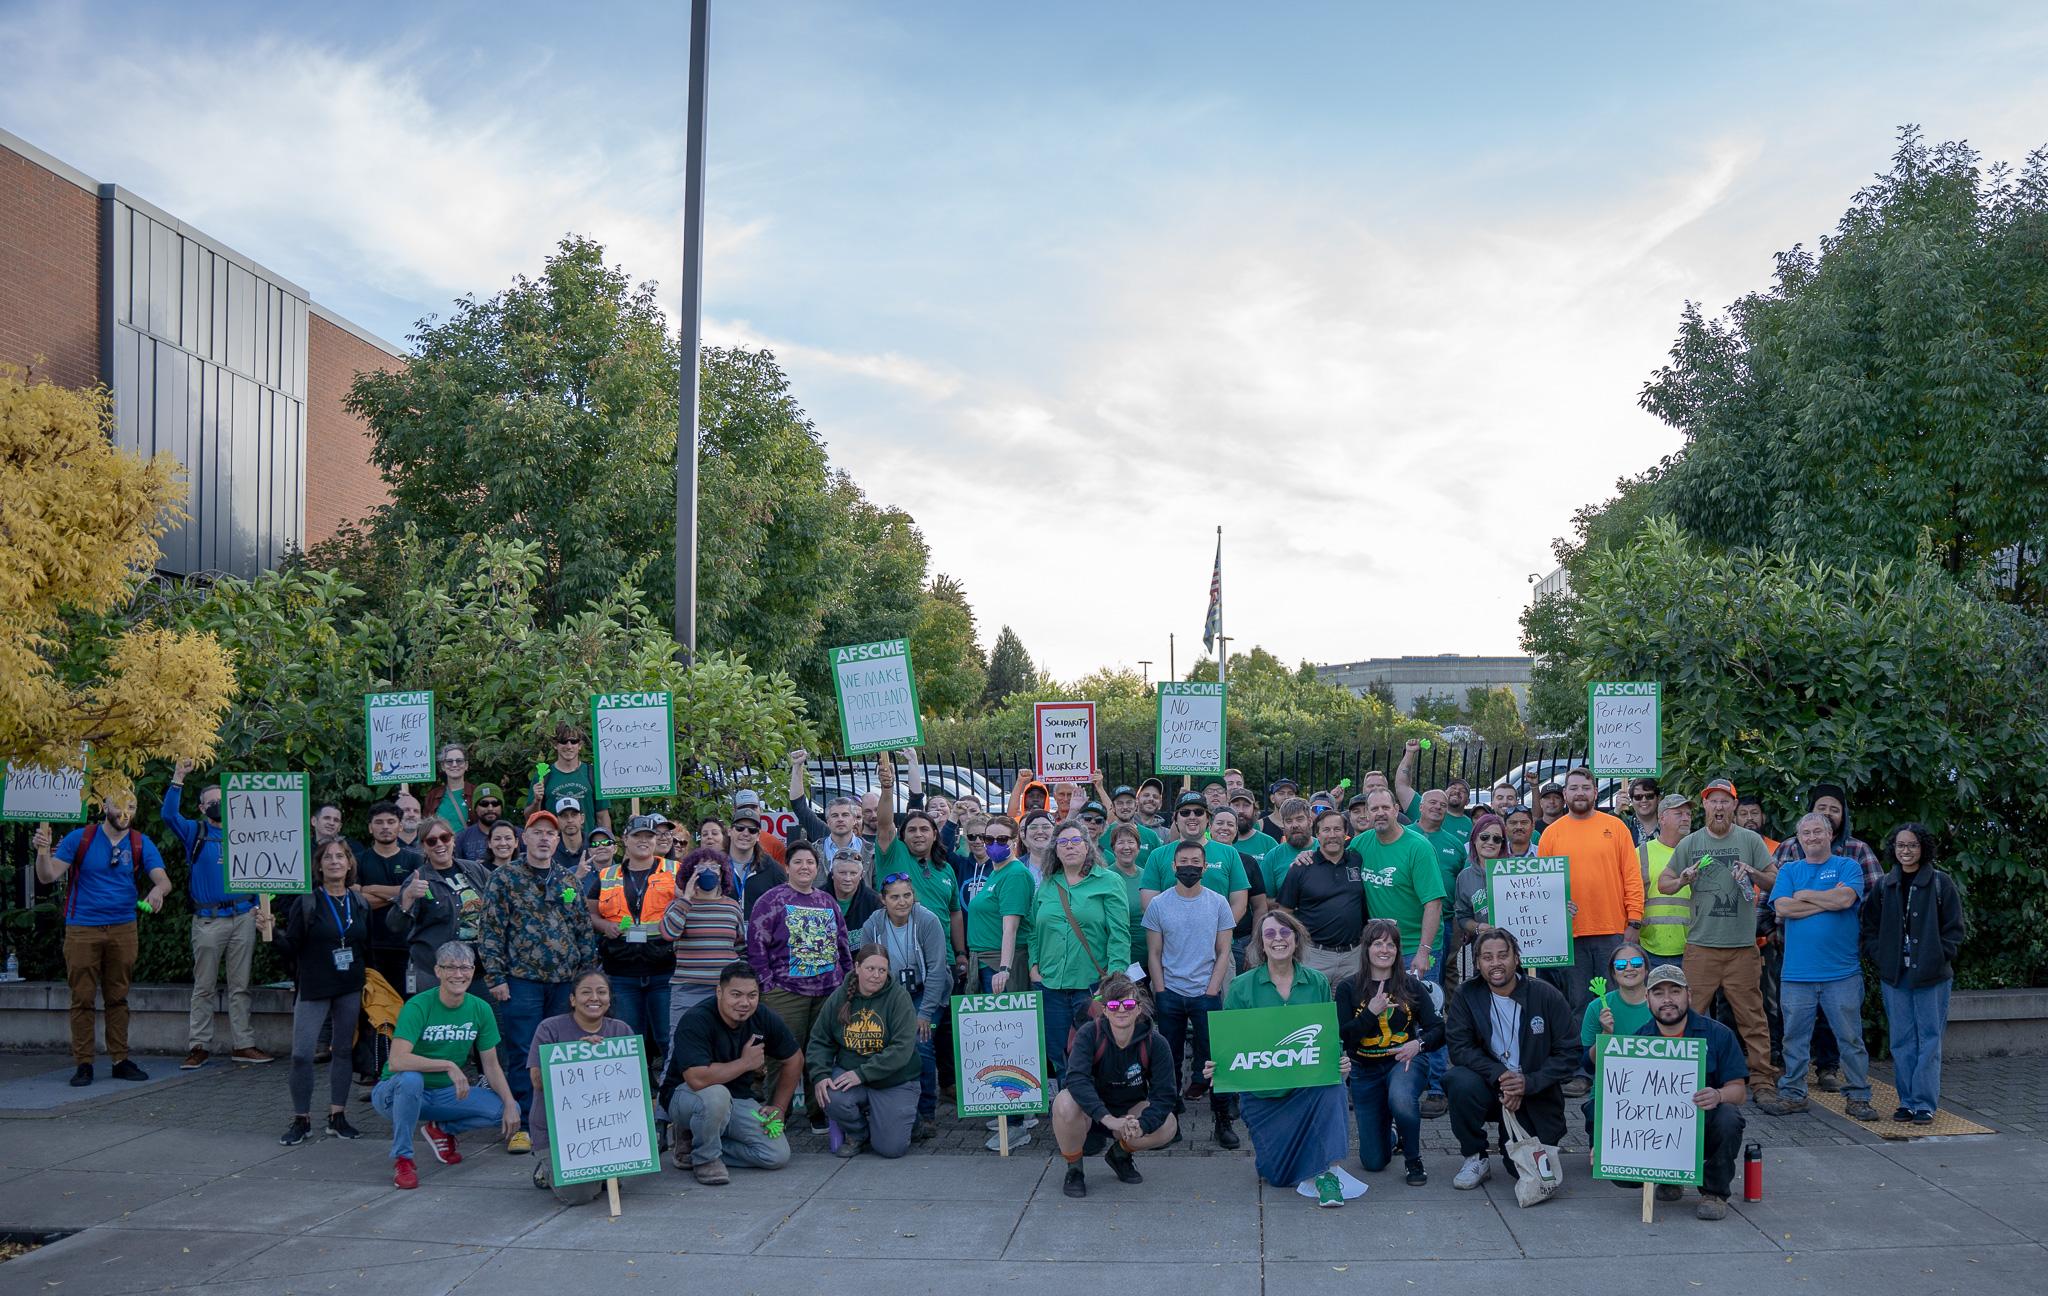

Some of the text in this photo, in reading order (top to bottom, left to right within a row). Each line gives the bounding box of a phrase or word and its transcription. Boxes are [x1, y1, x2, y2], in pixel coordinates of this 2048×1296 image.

[837, 641, 905, 663] AFSCME
[840, 667, 903, 689] WE MAKE
[1162, 683, 1223, 695] AFSCME
[1594, 683, 1657, 695] AFSCME
[370, 692, 429, 707] AFSCME
[597, 692, 667, 708] AFSCME
[847, 687, 909, 711] PORTLAND
[1170, 699, 1190, 716] NO
[1596, 701, 1650, 718] Portland
[373, 712, 427, 732] WE KEEP
[598, 717, 662, 734] Practice
[852, 708, 908, 733] HAPPEN
[1163, 719, 1219, 734] CONTRACT
[386, 732, 411, 744] THE
[1054, 731, 1077, 739] WITH
[1171, 732, 1192, 744] NO
[600, 736, 652, 752] Picket
[850, 741, 879, 751] OREGON
[879, 738, 908, 747] COUNCIL
[1046, 743, 1078, 760] CITY
[1598, 739, 1631, 749] when
[374, 745, 428, 762] WATER ON
[1164, 748, 1220, 760] SERVICES
[1600, 753, 1619, 765] We
[1046, 761, 1089, 771] WORKERS
[227, 774, 304, 790] AFSCME
[601, 787, 631, 795] OREGON
[631, 785, 661, 793] COUNCIL
[229, 794, 287, 820] FAIR
[229, 829, 298, 845] CONTRACT
[232, 850, 298, 878] NOW
[1493, 858, 1565, 875] AFSCME
[230, 881, 305, 889] OREGON COUNCIL 75
[1505, 890, 1551, 900] AFRAID
[1520, 905, 1529, 913] OF
[1508, 914, 1549, 926] LITTLE
[1520, 928, 1537, 938] OLD
[1523, 938, 1543, 948] ME?
[1527, 956, 1558, 964] COUNCIL
[958, 994, 1037, 1012] AFSCME
[422, 1030, 478, 1041] HARRIS
[847, 1031, 882, 1039] PORTLAND
[962, 1017, 1024, 1039] Standing
[549, 1038, 638, 1064] AFSCME
[843, 1037, 884, 1049] WATER
[994, 1037, 1015, 1051] for
[1604, 1037, 1699, 1059] AFSCME
[964, 1054, 1036, 1069] Our Families
[1229, 1047, 1320, 1071] AFSCME
[560, 1062, 626, 1087] 189 FOR
[1606, 1068, 1696, 1097] WE MAKE
[562, 1087, 642, 1111] A SAFE AND
[964, 1104, 996, 1112] OREGON
[997, 1102, 1031, 1110] COUNCIL
[1616, 1099, 1695, 1121] PORTLAND
[576, 1110, 632, 1134] HEALTHY
[567, 1132, 643, 1161] PORTLAND
[1611, 1126, 1683, 1151] HAPPEN
[561, 1167, 600, 1179] OREGON
[601, 1162, 640, 1173] COUNCIL
[642, 1160, 653, 1168] 75
[1601, 1165, 1640, 1175] OREGON
[1641, 1169, 1682, 1179] COUNCIL
[1684, 1171, 1696, 1180] 75
